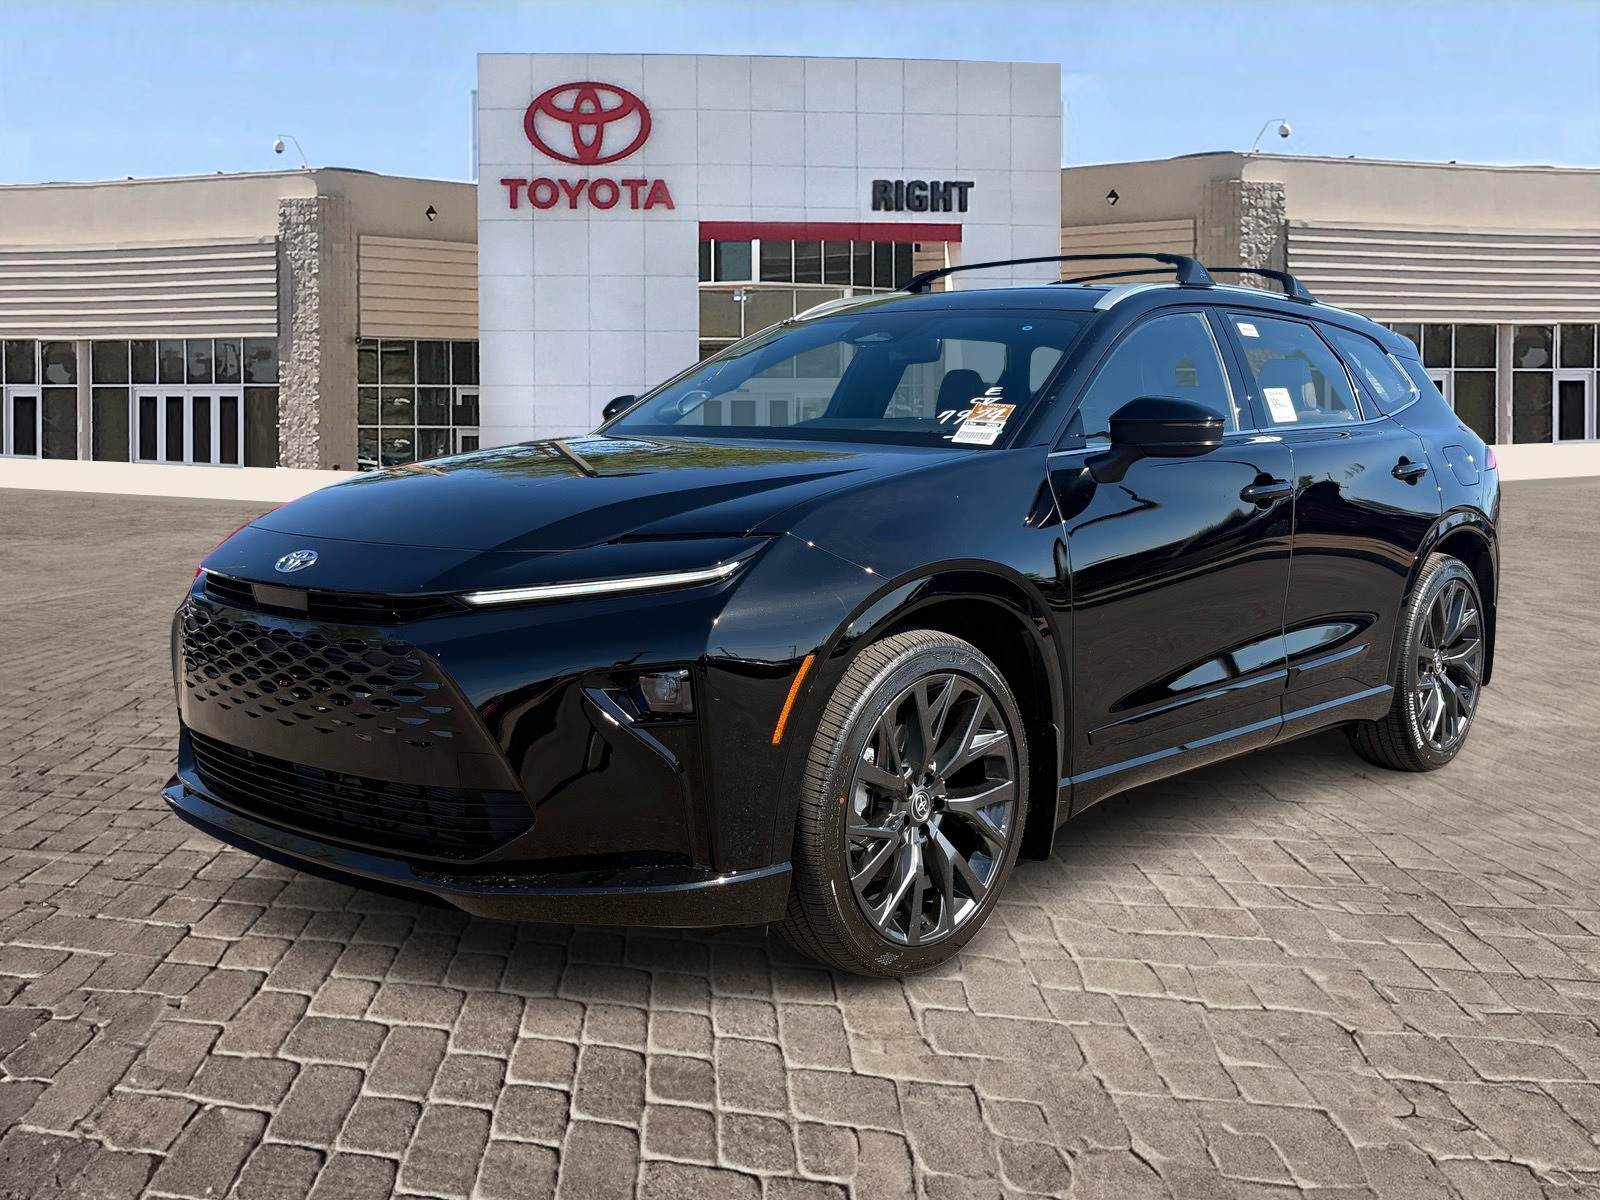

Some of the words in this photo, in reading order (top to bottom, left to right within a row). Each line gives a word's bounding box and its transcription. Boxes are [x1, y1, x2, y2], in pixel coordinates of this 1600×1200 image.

[500, 178, 675, 210] TOYOTA
[872, 180, 975, 212] RIGHT
[1408, 691, 1424, 749] BRIDGESTONE
